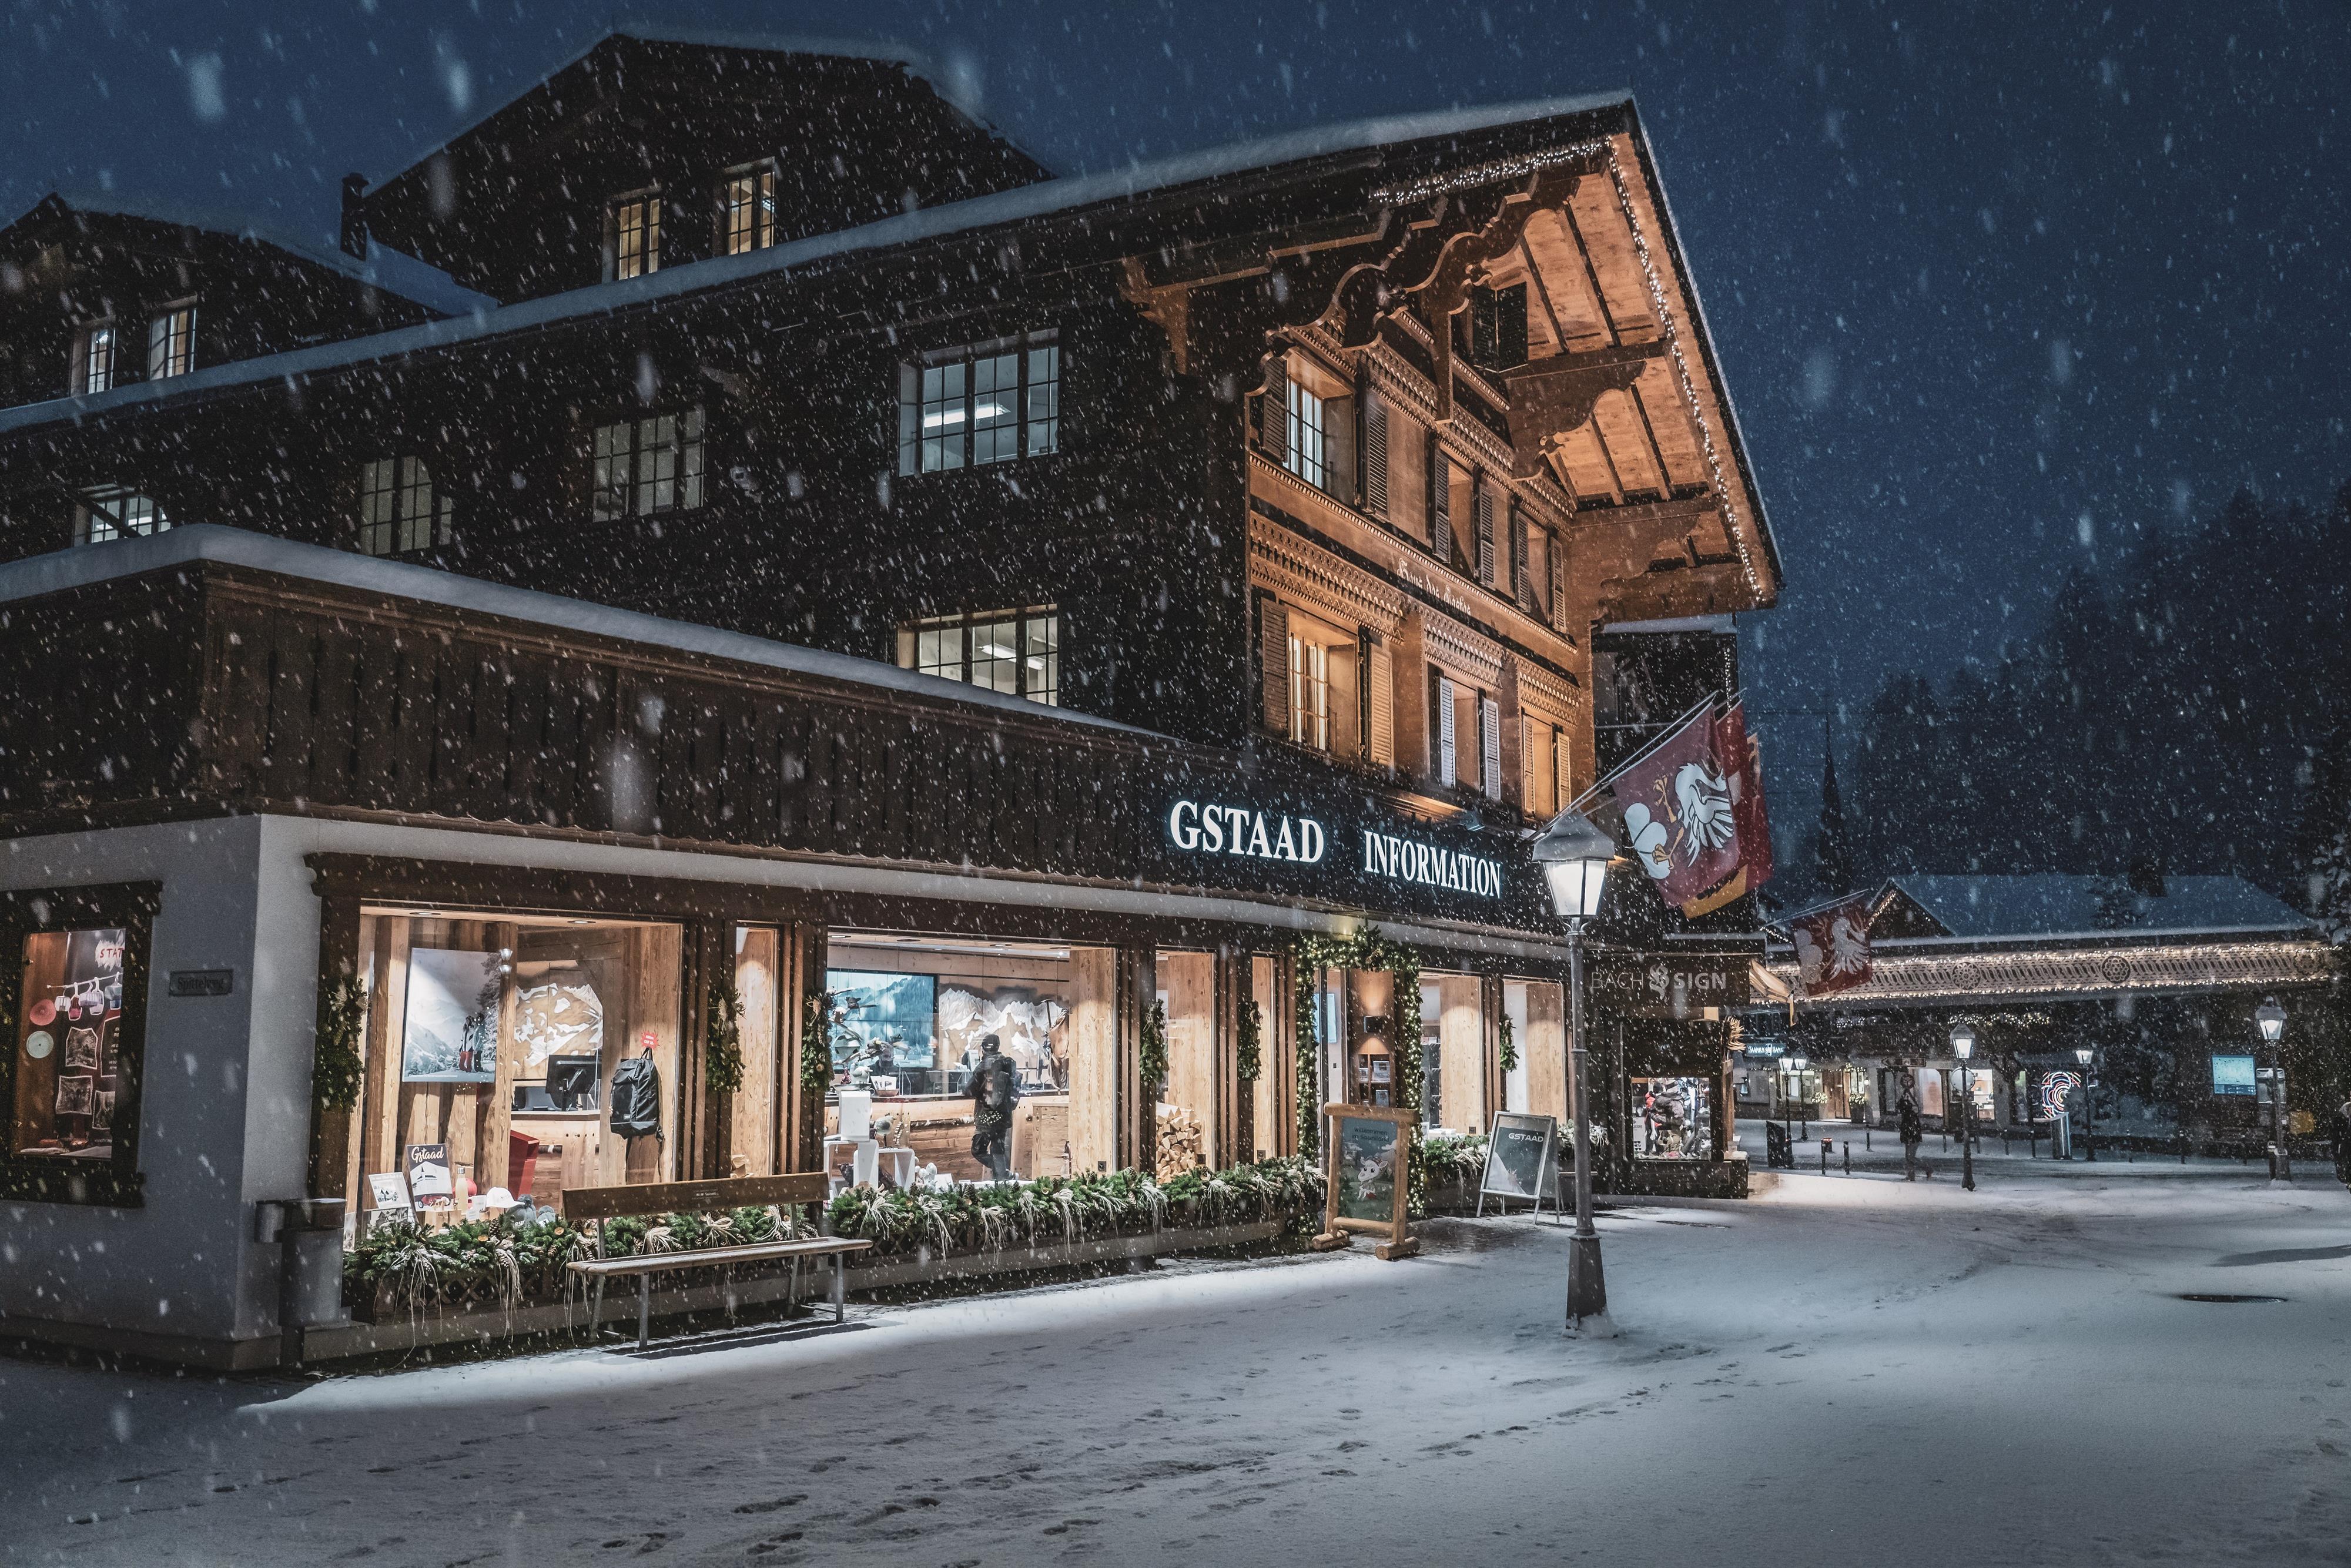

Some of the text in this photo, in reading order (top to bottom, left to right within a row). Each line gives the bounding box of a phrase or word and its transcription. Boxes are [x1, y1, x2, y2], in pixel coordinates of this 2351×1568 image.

[1170, 800, 1501, 899] GSTAAD INFORMATION
[1591, 971, 1726, 990] BACH SIGN
[1508, 1133, 1544, 1143] GSTAAD
[411, 1146, 444, 1164] Gstaad
